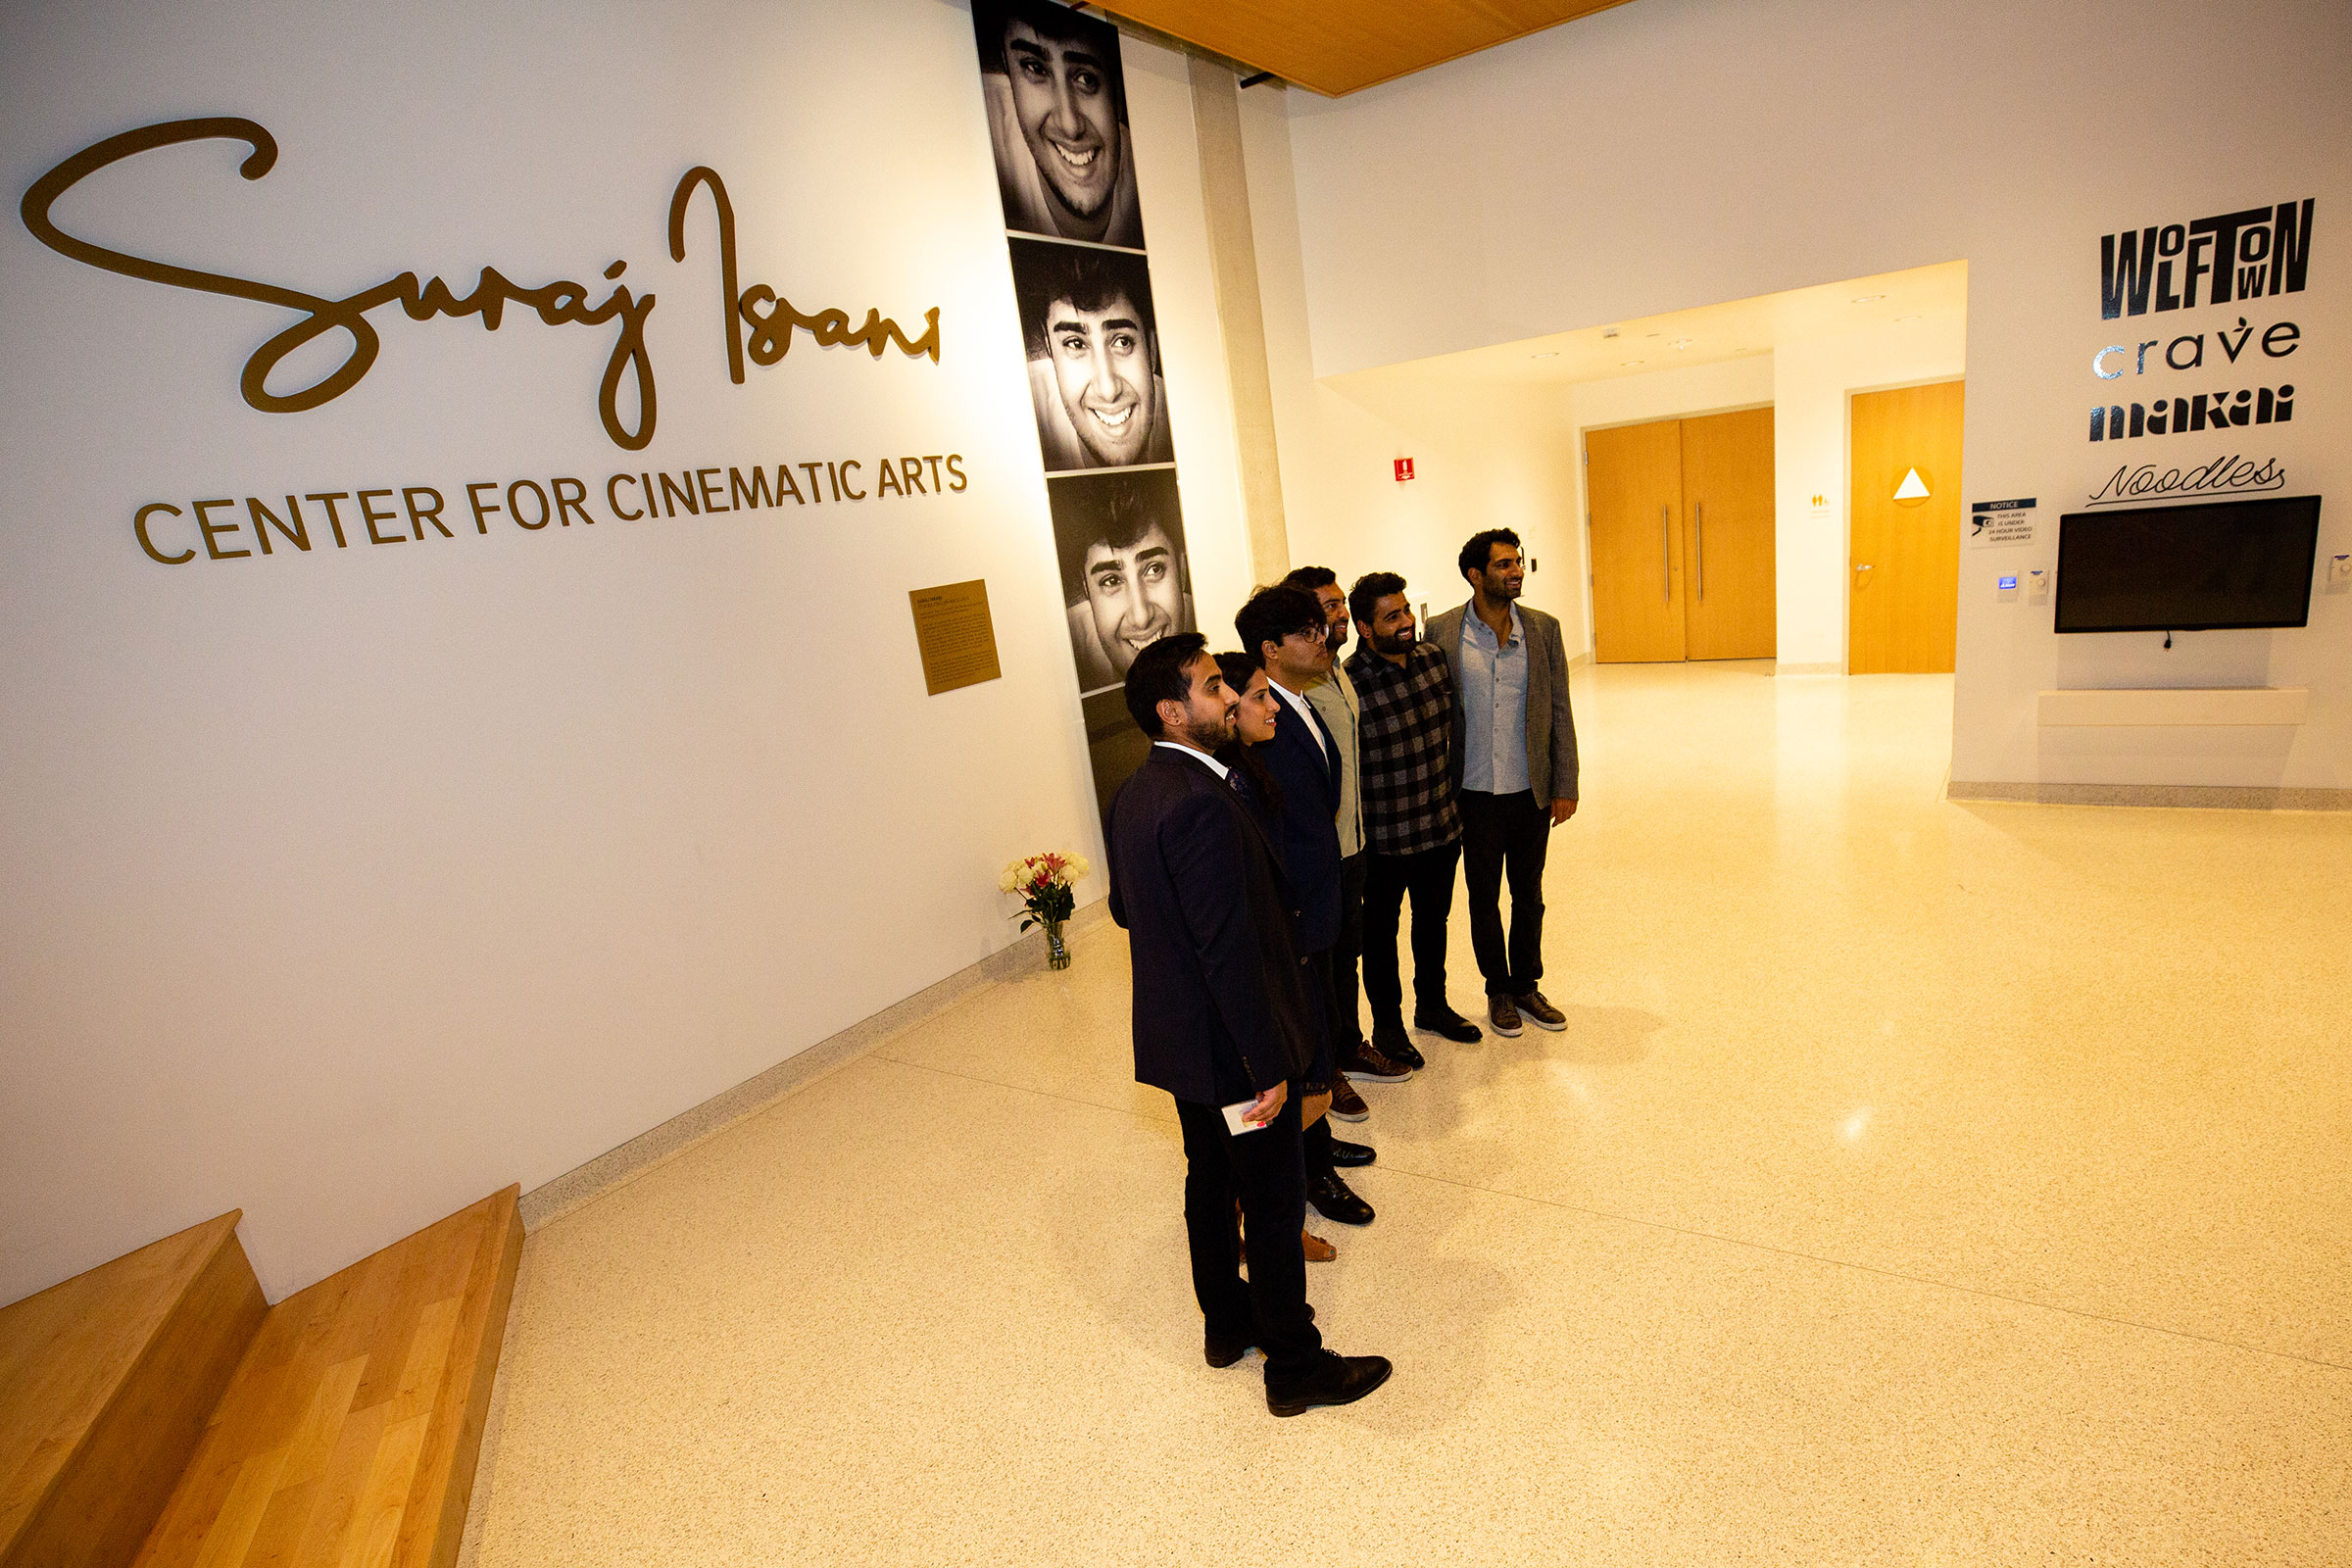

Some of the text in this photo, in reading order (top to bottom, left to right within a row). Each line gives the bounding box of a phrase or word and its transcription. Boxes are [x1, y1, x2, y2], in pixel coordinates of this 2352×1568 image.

[21, 117, 657, 451] Suraj
[2092, 317, 2300, 380] crave
[133, 454, 968, 565] CENTER FOR CINEMATIC ARTS
[1989, 501, 2019, 510] NOTICE
[2087, 455, 2285, 503] Noodles
